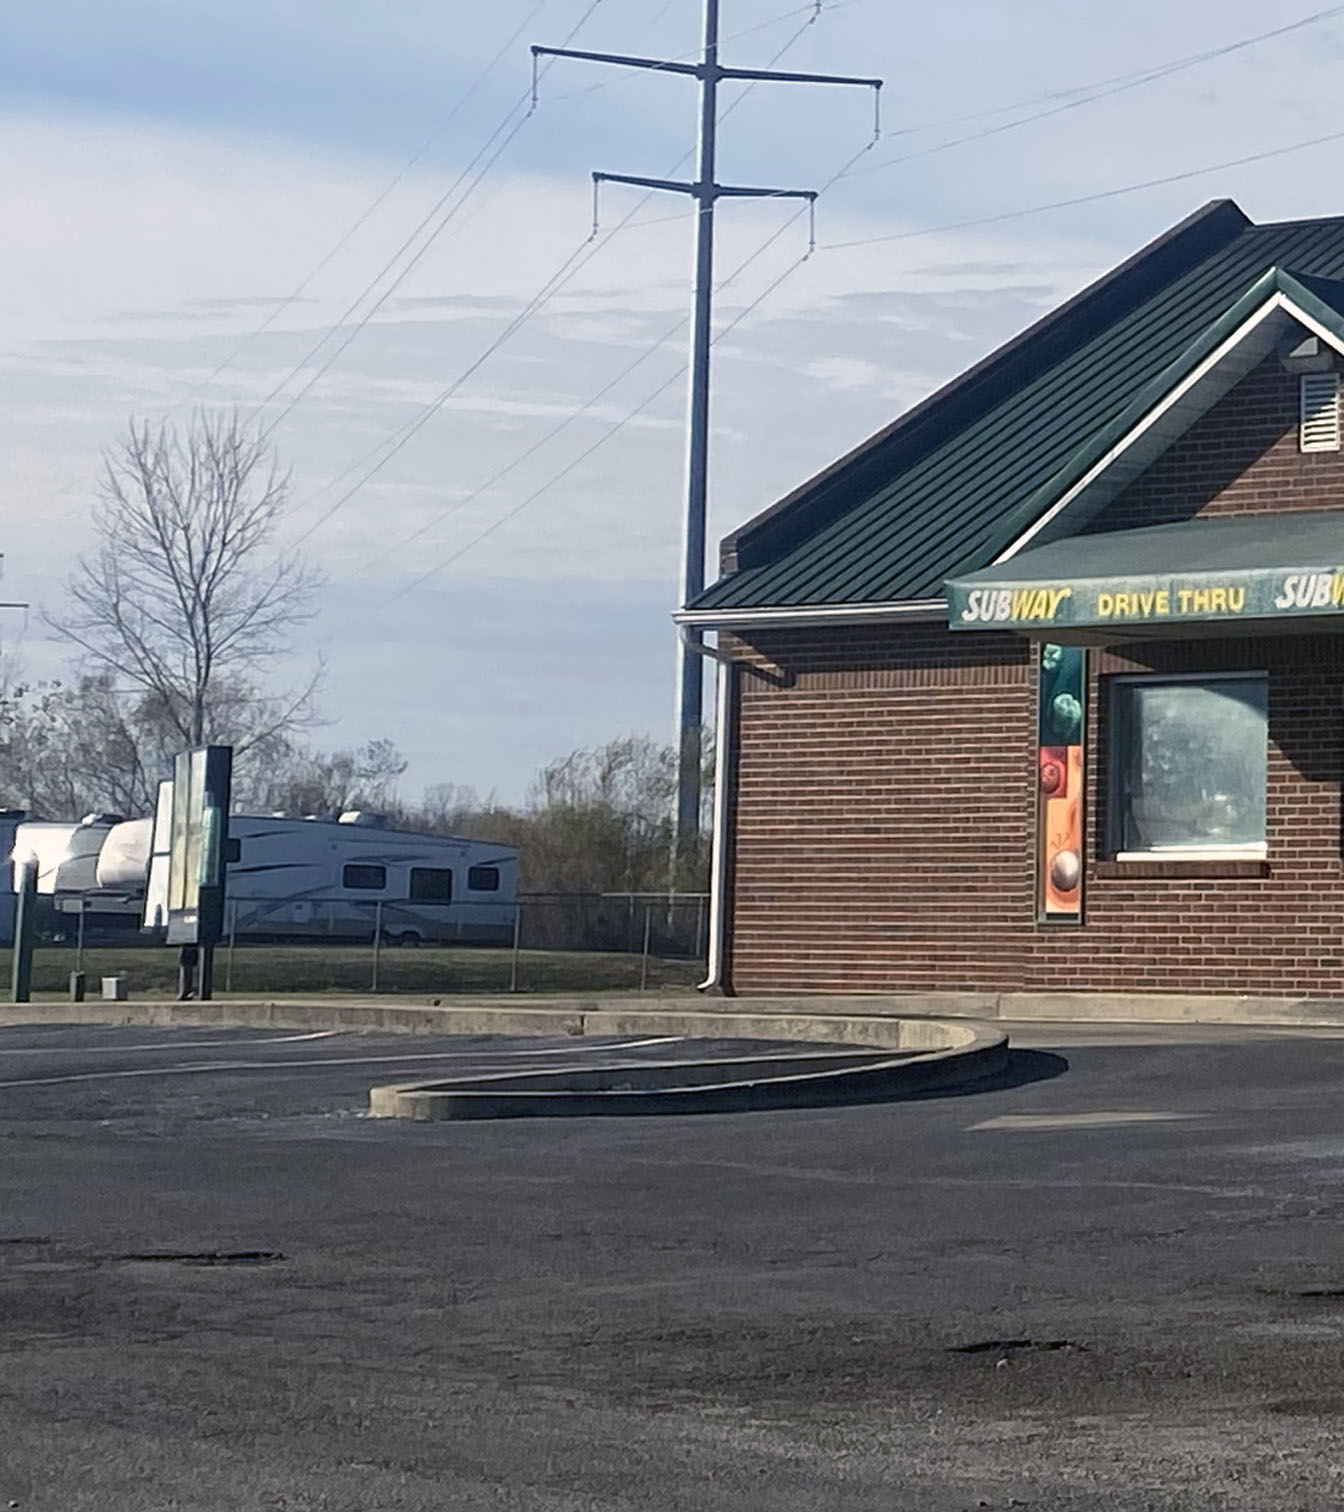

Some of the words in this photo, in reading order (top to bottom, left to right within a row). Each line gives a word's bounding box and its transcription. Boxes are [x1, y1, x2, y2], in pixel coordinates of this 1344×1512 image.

[961, 587, 1072, 623] SUBWAY
[1098, 588, 1170, 618] DRIVE
[1178, 586, 1246, 613] THRU
